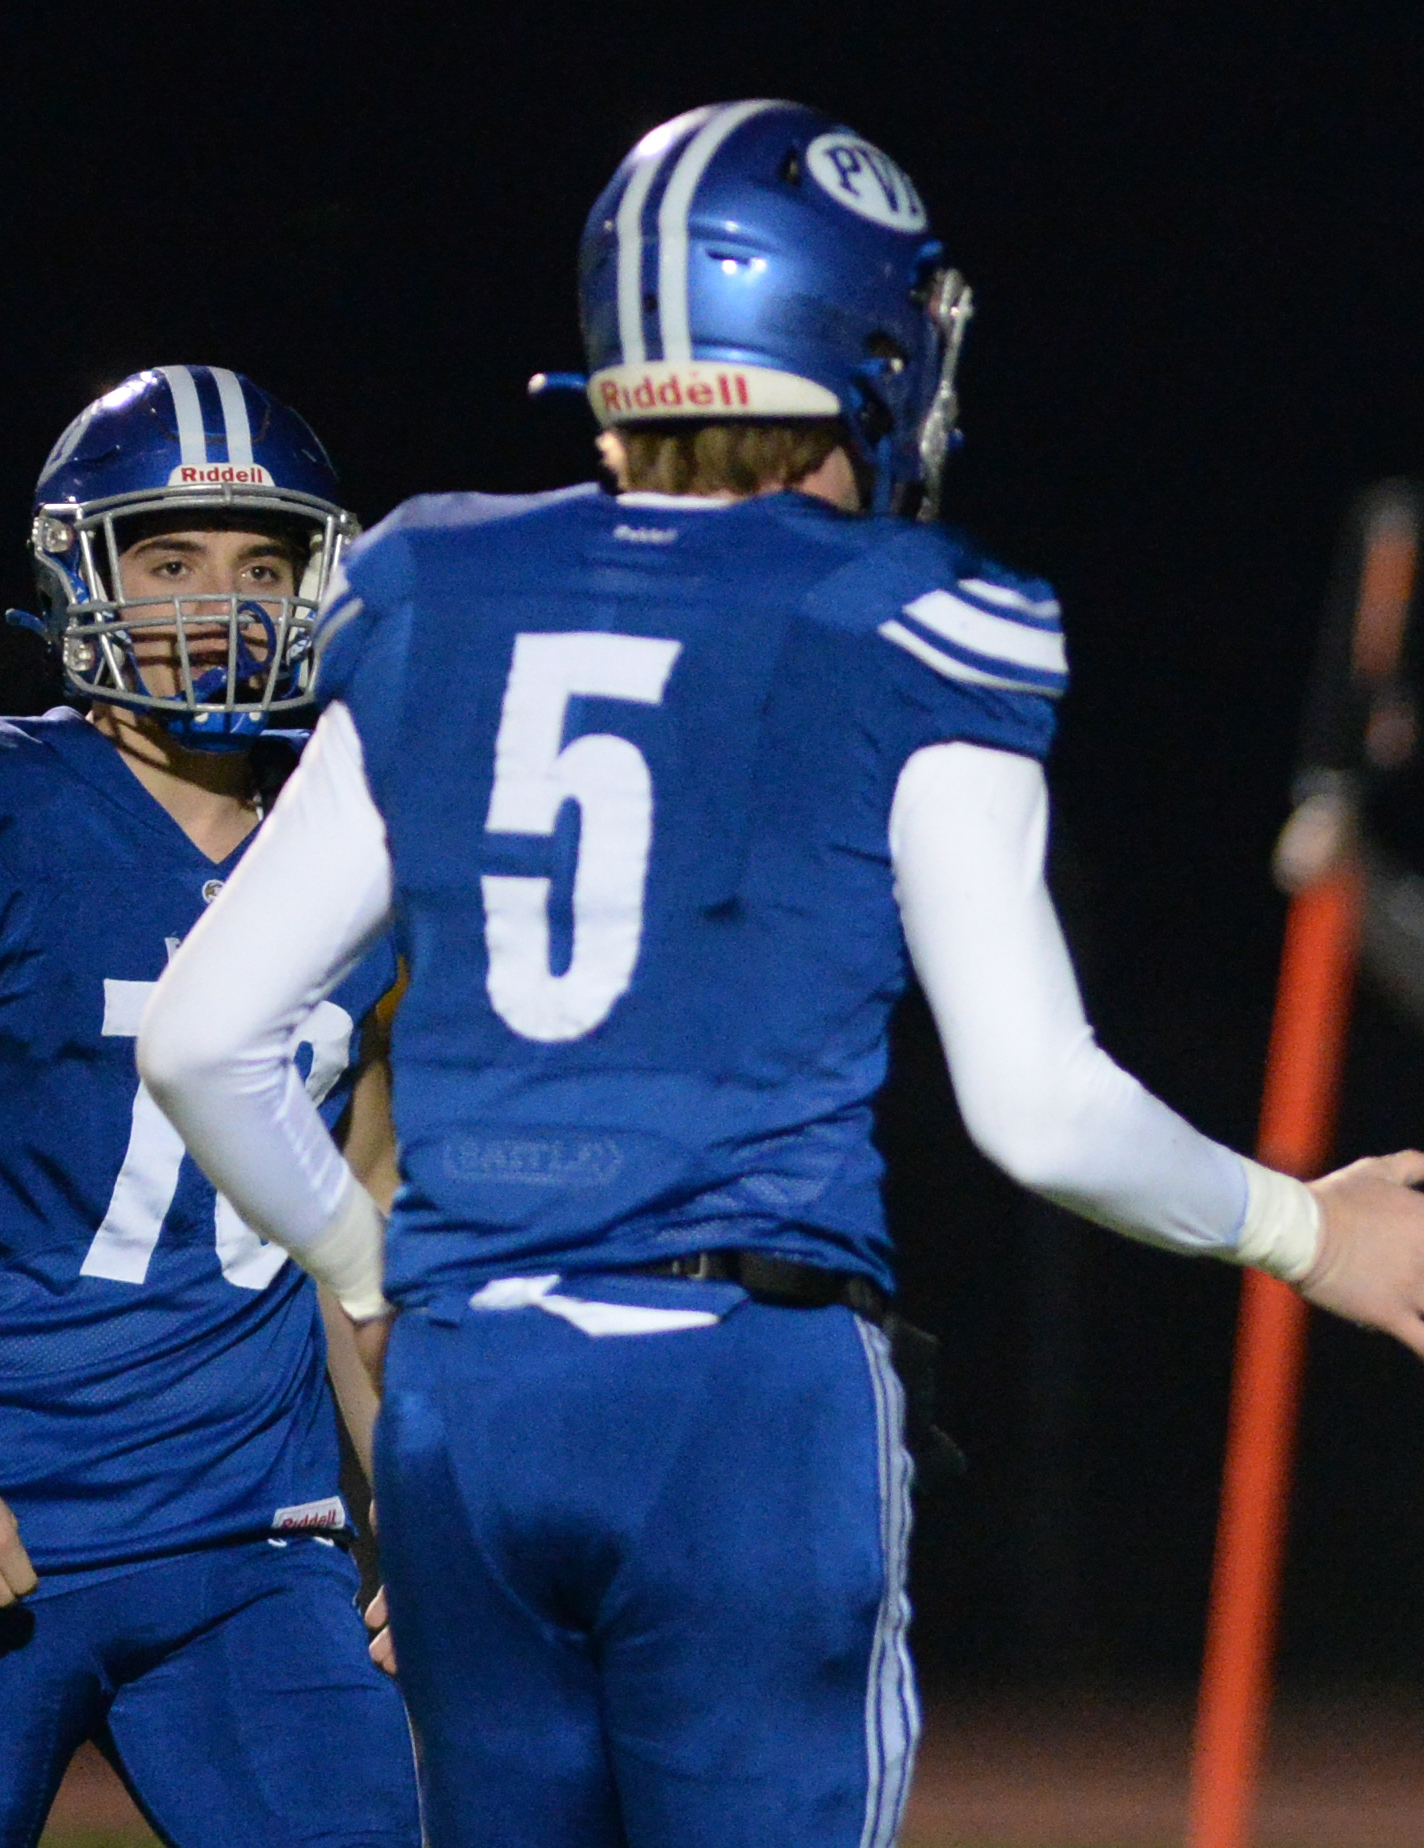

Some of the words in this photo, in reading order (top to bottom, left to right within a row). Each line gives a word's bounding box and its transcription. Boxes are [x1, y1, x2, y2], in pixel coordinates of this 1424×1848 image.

[600, 373, 749, 413] Riddell
[180, 466, 264, 483] Riddell
[481, 631, 684, 1043] 5
